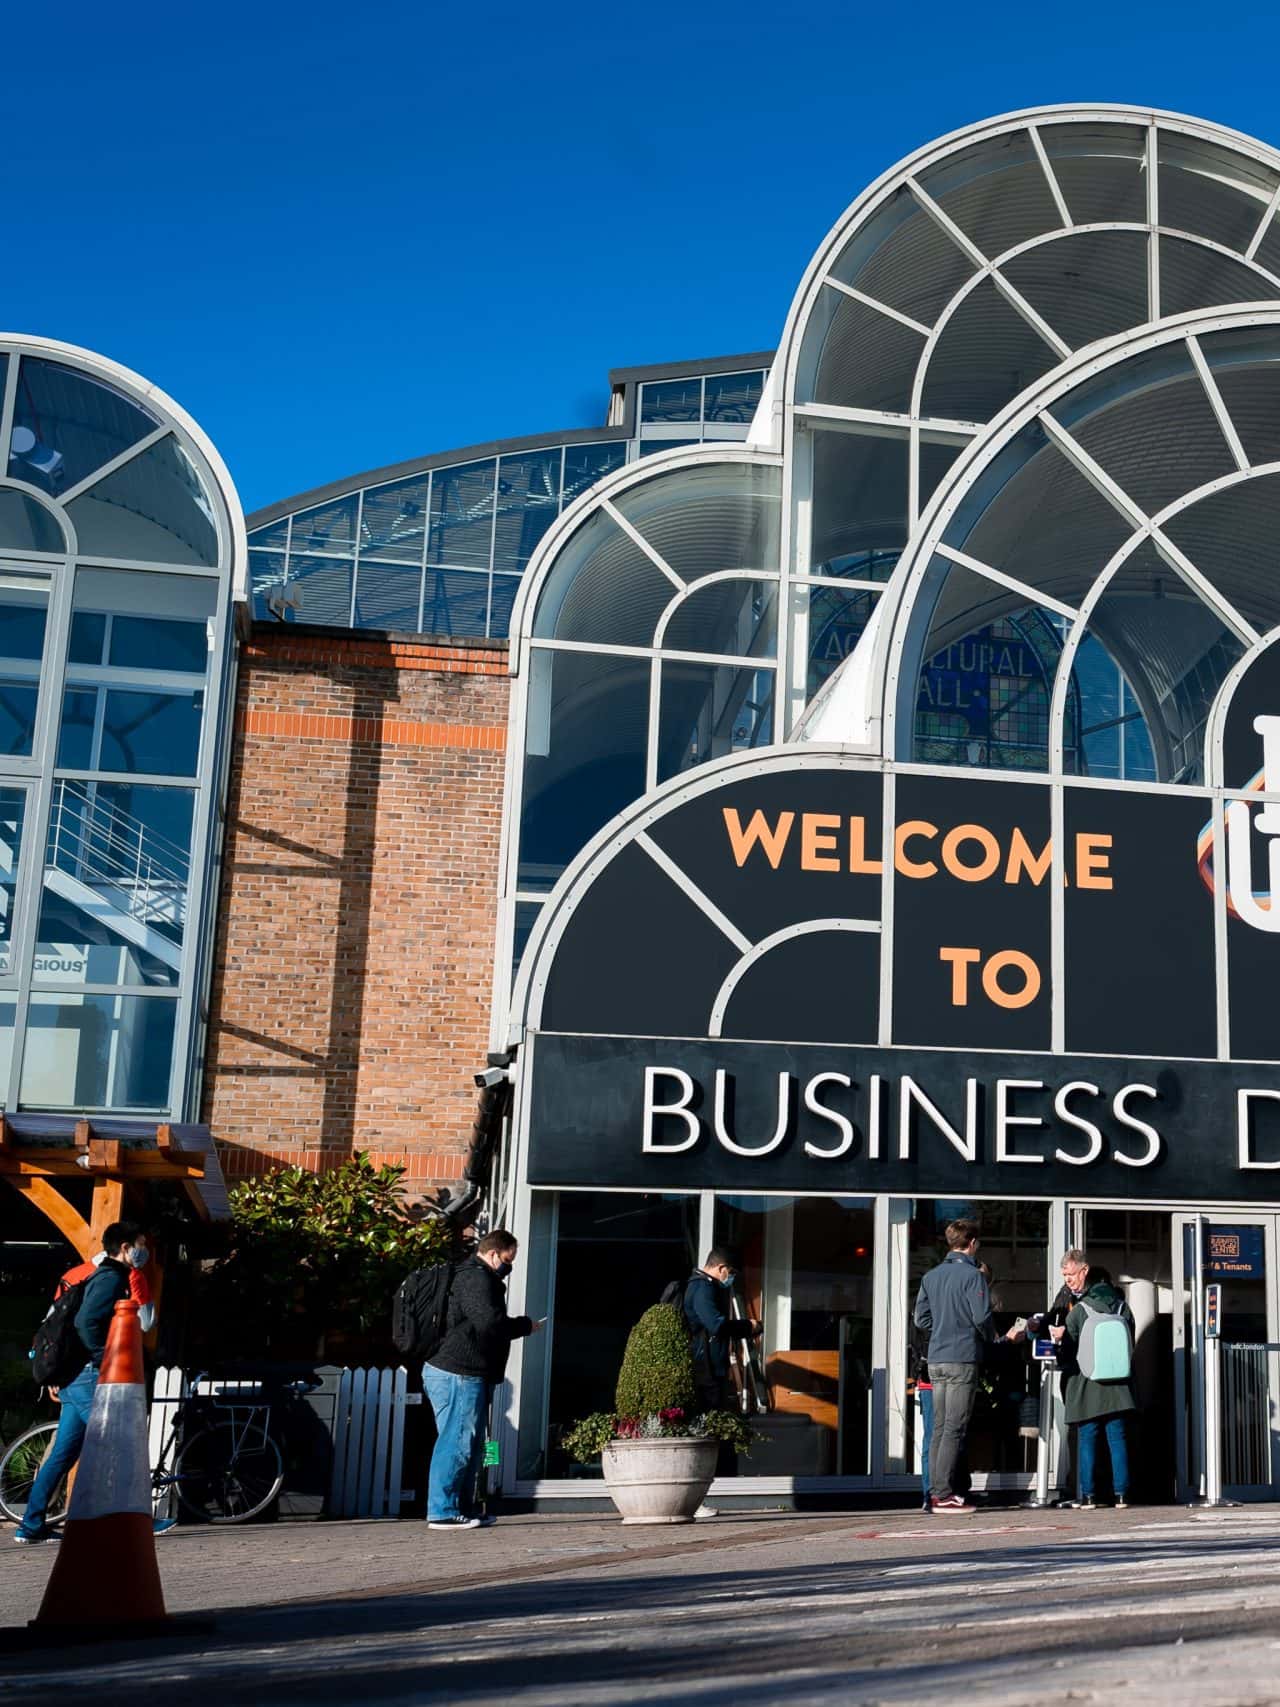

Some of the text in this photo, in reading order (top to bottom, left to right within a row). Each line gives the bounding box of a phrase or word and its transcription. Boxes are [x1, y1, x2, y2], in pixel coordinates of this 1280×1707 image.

[723, 807, 1114, 890] WELCOME
[939, 947, 1041, 1009] TO
[642, 1066, 1160, 1167] BUSINESS
[1222, 1262, 1252, 1271] Tenants
